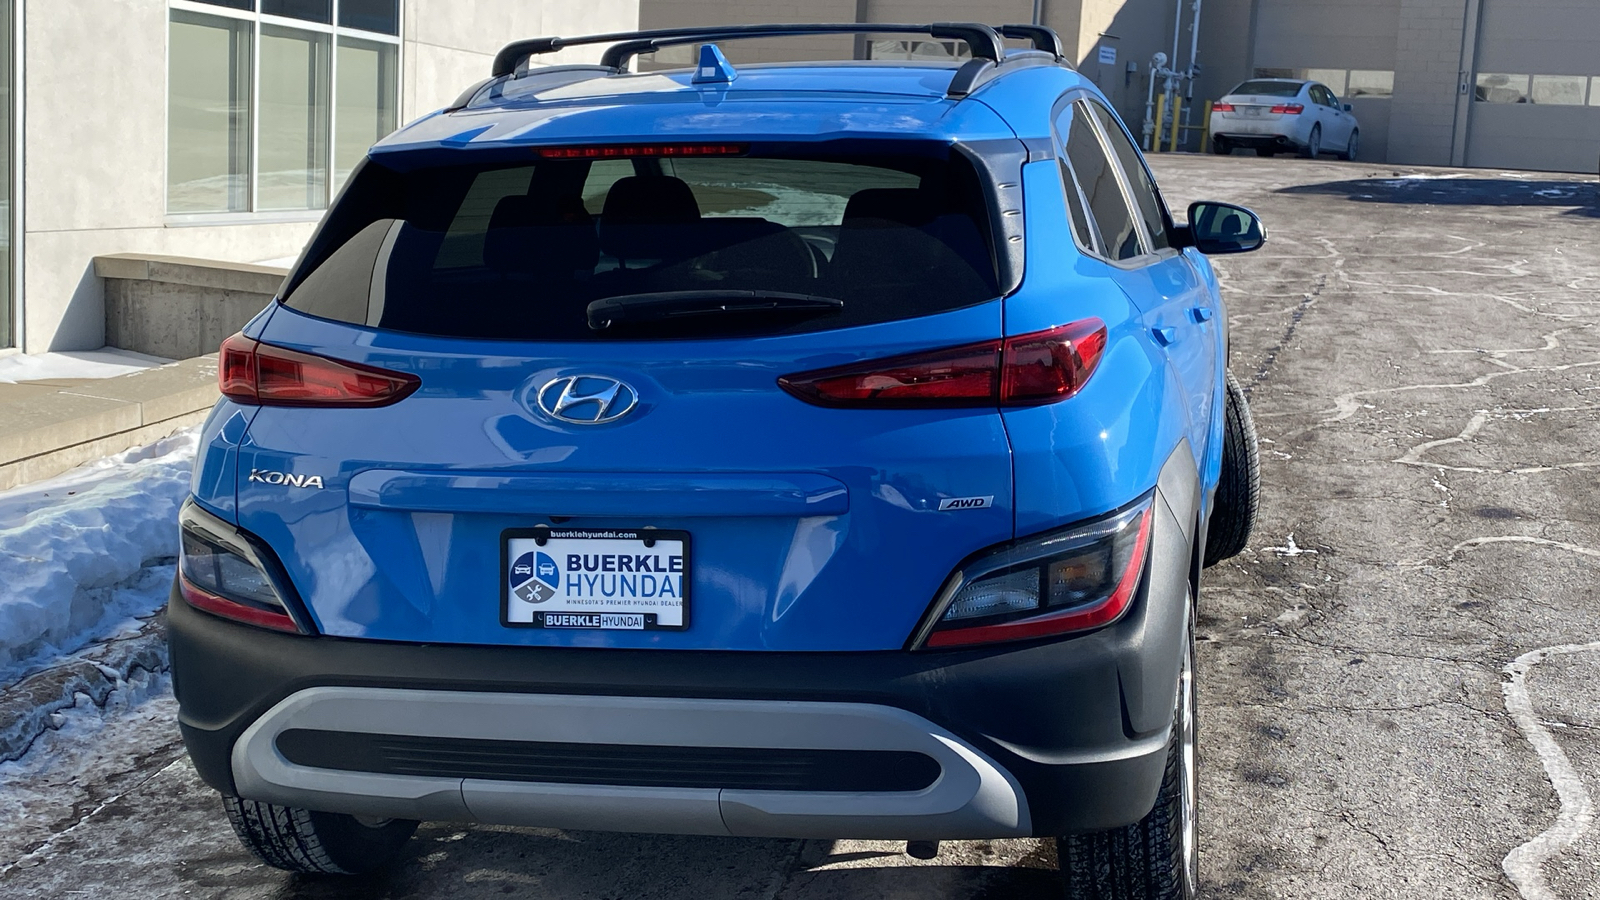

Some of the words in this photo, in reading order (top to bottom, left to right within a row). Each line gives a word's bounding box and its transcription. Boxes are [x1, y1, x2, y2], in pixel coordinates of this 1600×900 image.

[248, 468, 324, 489] KONA
[946, 498, 985, 508] AWD
[550, 531, 637, 539] buerklehyundai.com
[566, 554, 683, 572] BUERKLE
[566, 574, 683, 597] HYUNDAI
[546, 614, 600, 626] BUERKLE
[602, 616, 642, 627] HYUNDAI
